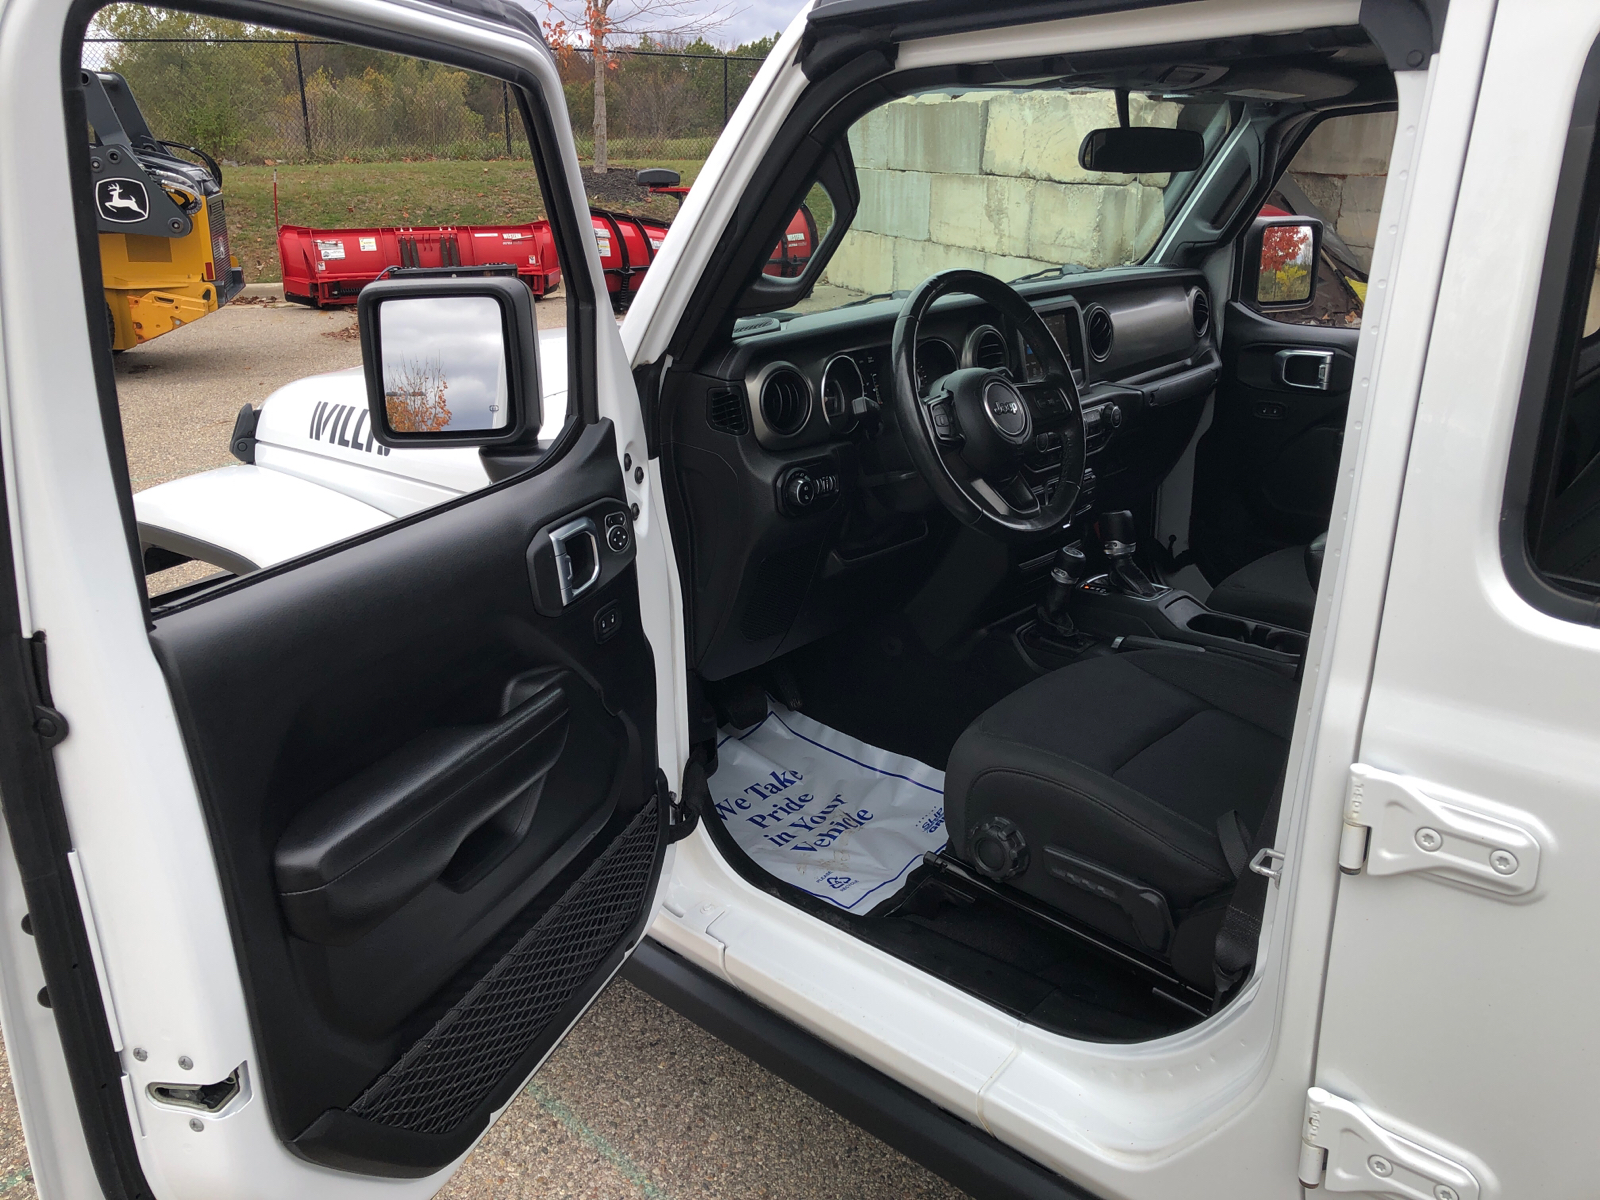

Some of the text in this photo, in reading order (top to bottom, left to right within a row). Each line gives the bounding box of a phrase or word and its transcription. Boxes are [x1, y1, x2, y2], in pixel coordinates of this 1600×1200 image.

[309, 401, 391, 457] WILL
[994, 401, 1018, 415] Jeep
[714, 770, 804, 822] We Take
[746, 793, 814, 829] Pride
[921, 807, 943, 828] SLIP
[763, 794, 847, 847] in Your
[790, 808, 874, 852] Vehicle
